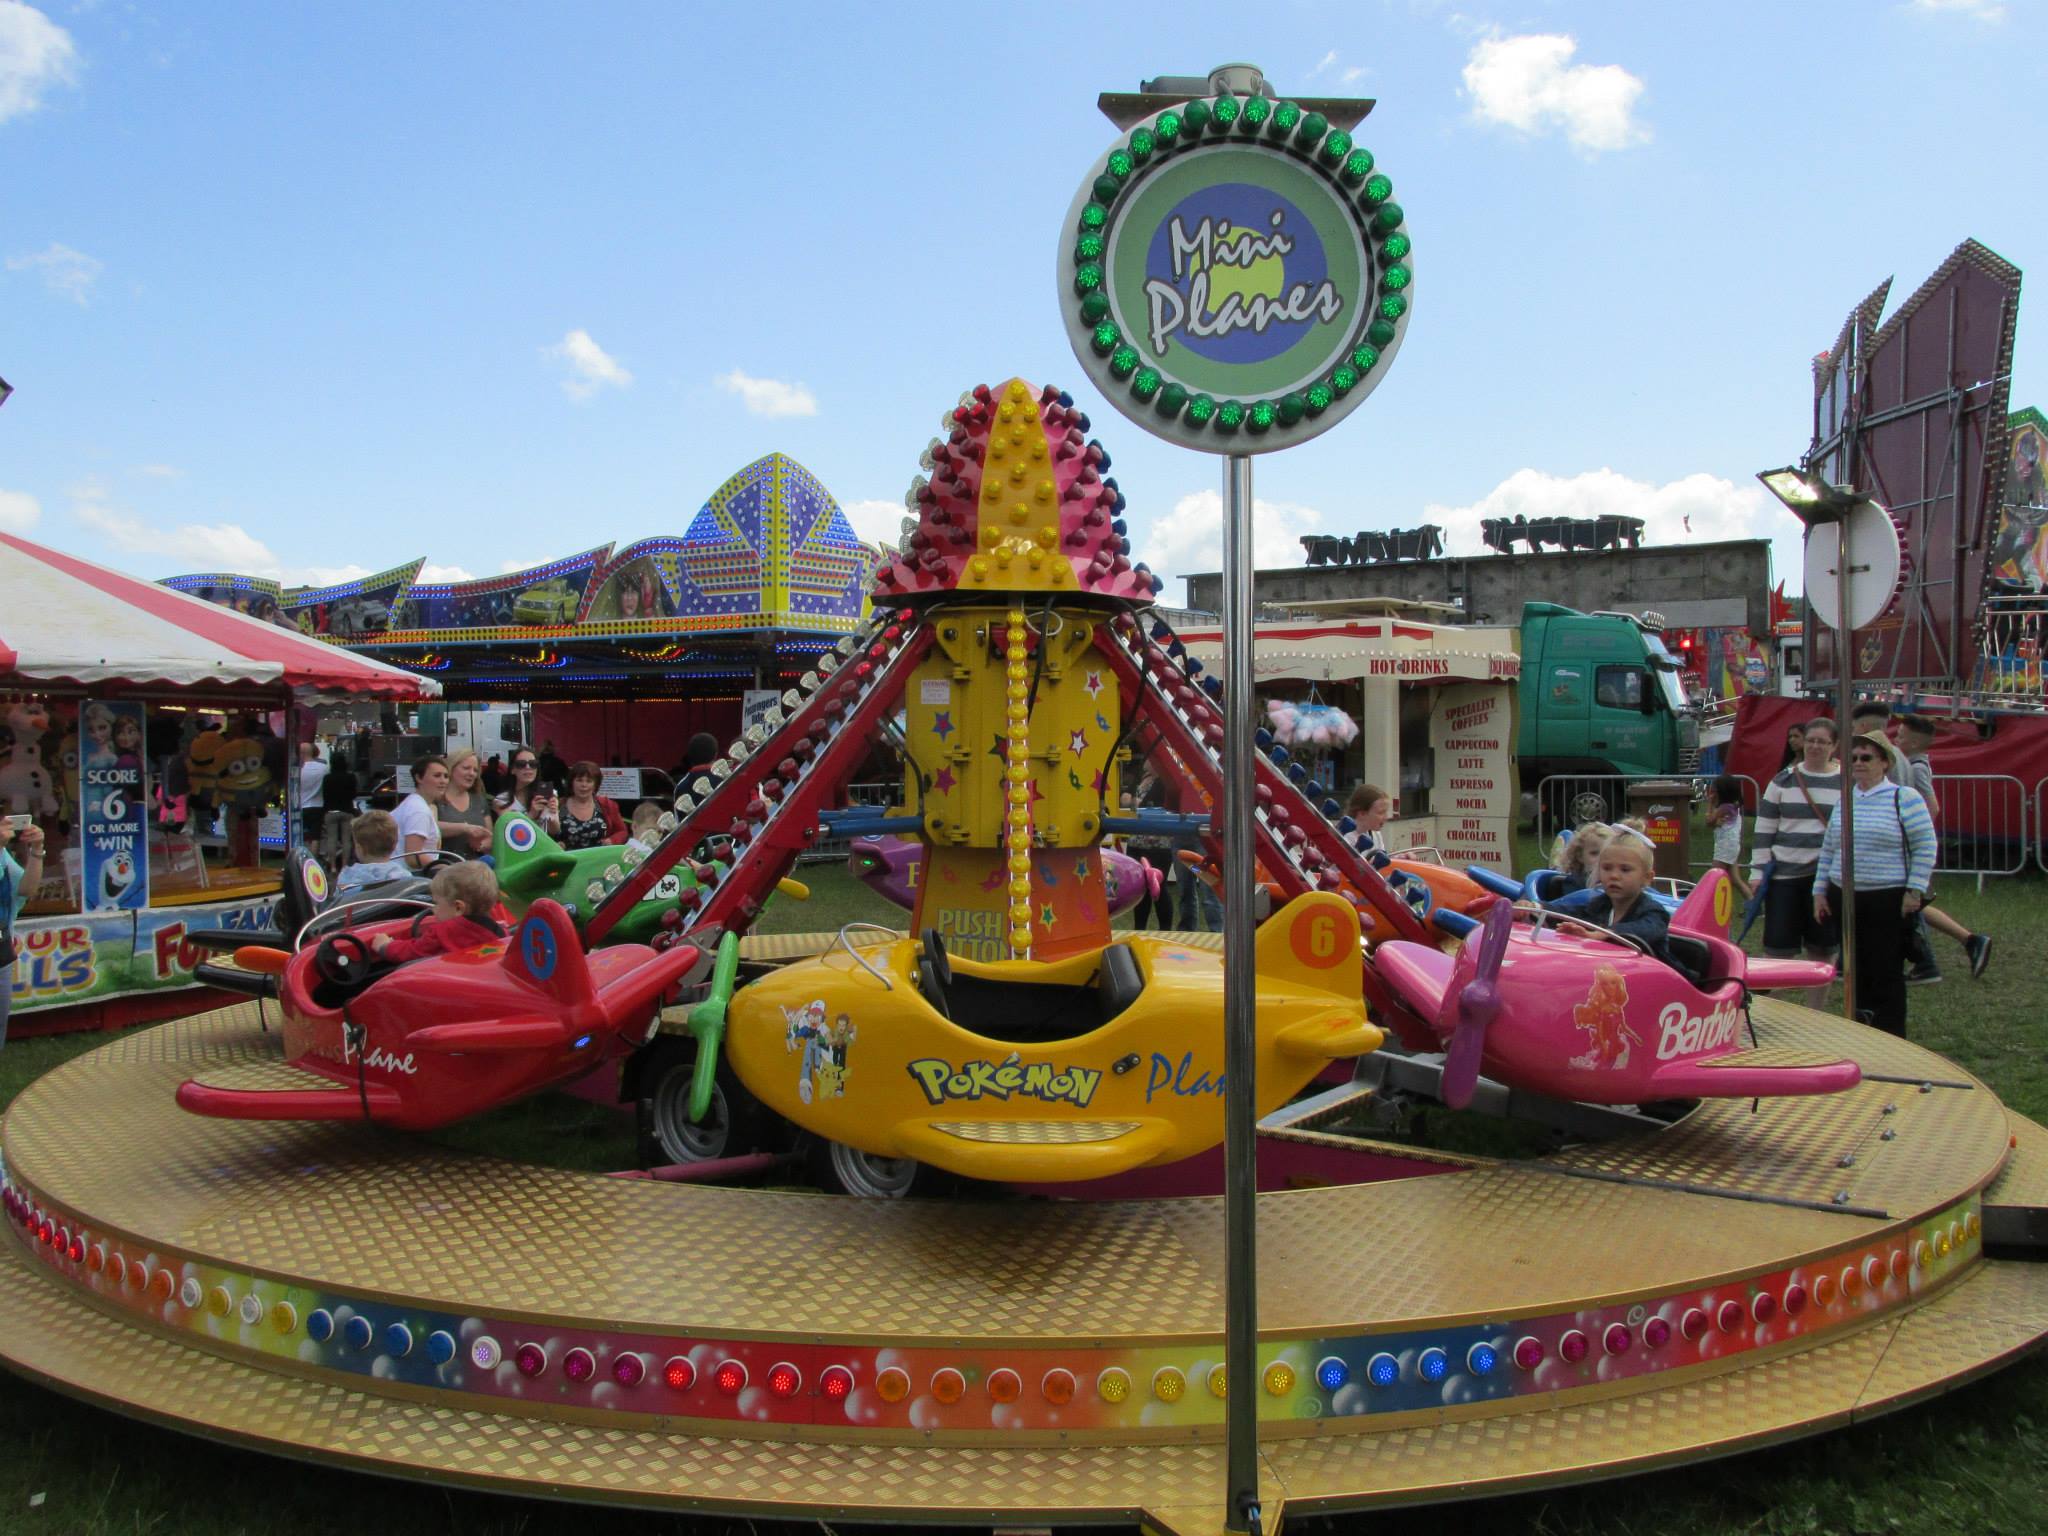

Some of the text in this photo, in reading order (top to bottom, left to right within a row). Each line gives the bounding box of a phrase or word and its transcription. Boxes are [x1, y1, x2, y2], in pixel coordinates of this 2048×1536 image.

[1170, 210, 1293, 276] Mini
[1146, 272, 1342, 354] Planes
[1370, 659, 1449, 675] HOT DRINKS
[1445, 697, 1496, 720] SPECIALIST
[1451, 712, 1489, 732] COFFEES
[1445, 739, 1499, 750] CAPPUCCINO
[1457, 758, 1485, 769] LATTE
[87, 769, 139, 785] SCORE
[1449, 778, 1494, 790] ESPRESSO
[102, 788, 127, 821] 6
[1456, 798, 1487, 809] MOCHA
[88, 822, 140, 834] OR MORE
[1462, 819, 1481, 830] HOT
[98, 835, 133, 851] WIN
[1446, 830, 1497, 842] CHOCOLATE
[1443, 849, 1502, 862] CHOCCO MILK
[1721, 886, 1728, 917] 7
[938, 908, 1004, 937] PUSH
[14, 927, 91, 954] UR
[1311, 915, 1336, 957] 6
[531, 927, 546, 969] 5
[1656, 1000, 1739, 1060] Barbie
[1146, 1051, 1227, 1104] Pla
